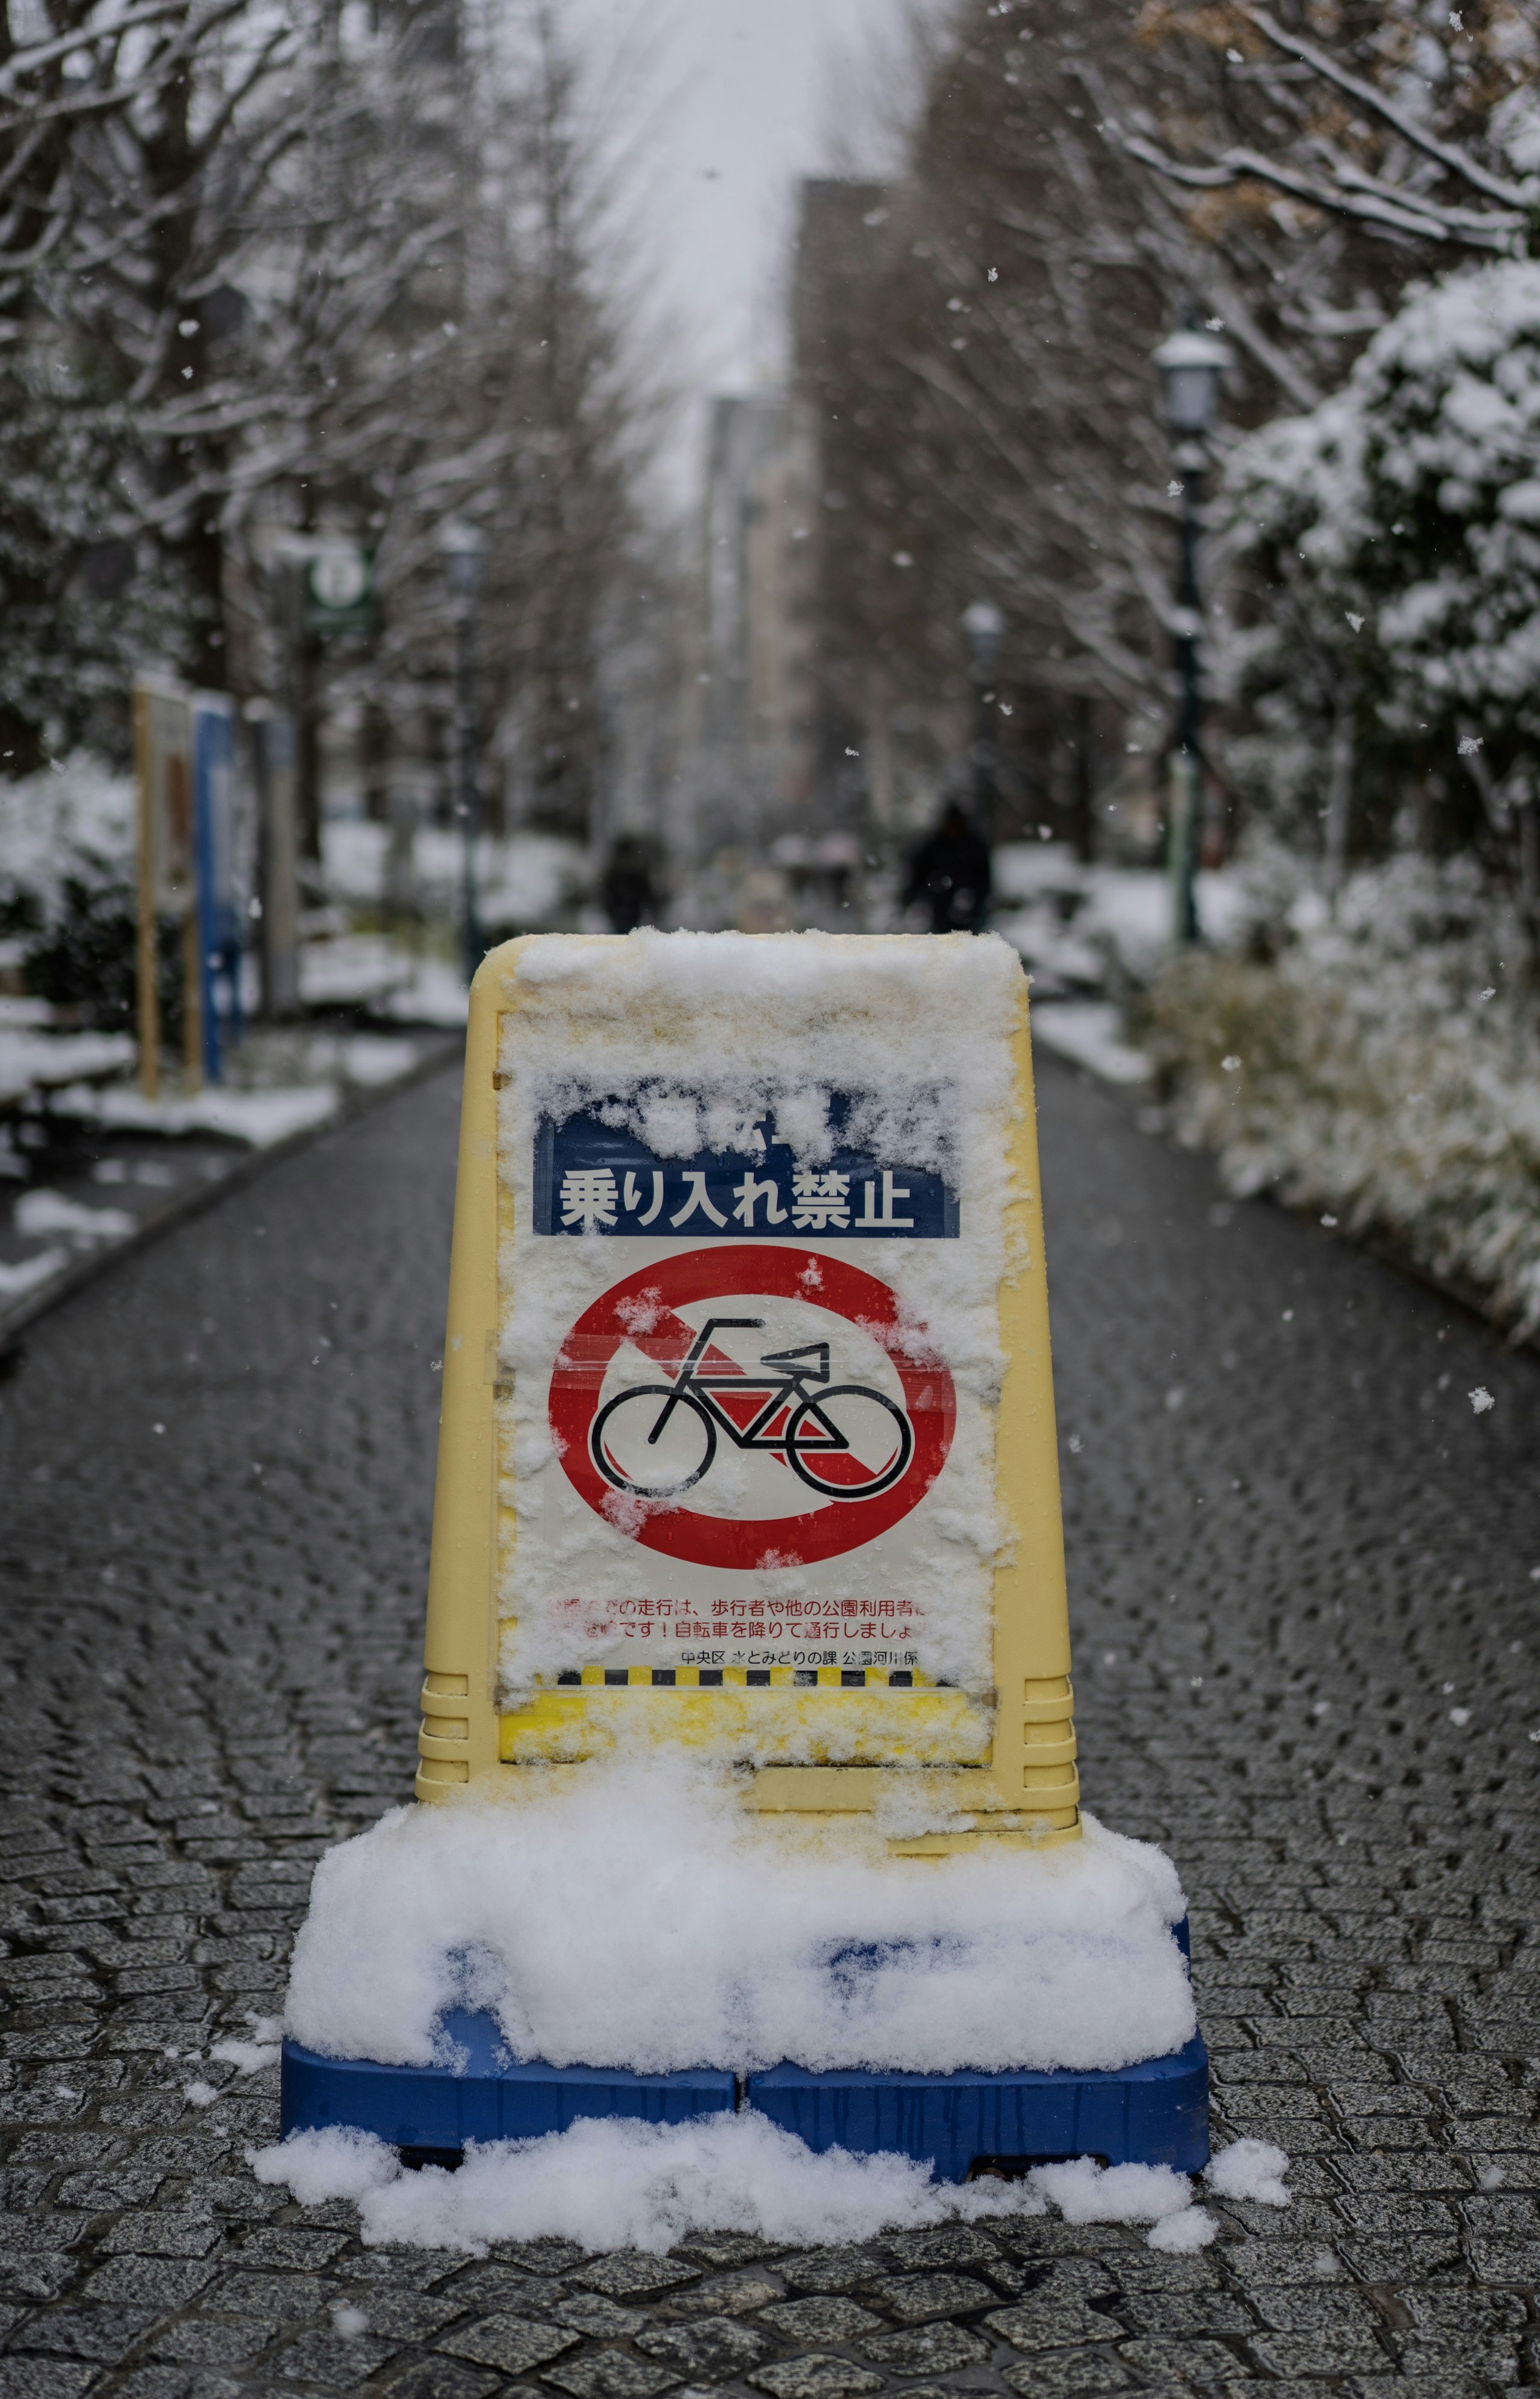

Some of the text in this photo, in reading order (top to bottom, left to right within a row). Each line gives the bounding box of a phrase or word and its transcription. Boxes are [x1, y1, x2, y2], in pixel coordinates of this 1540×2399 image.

[560, 1168, 915, 1229] 乗り入れ禁止
[681, 1651, 726, 1664] 中央区
